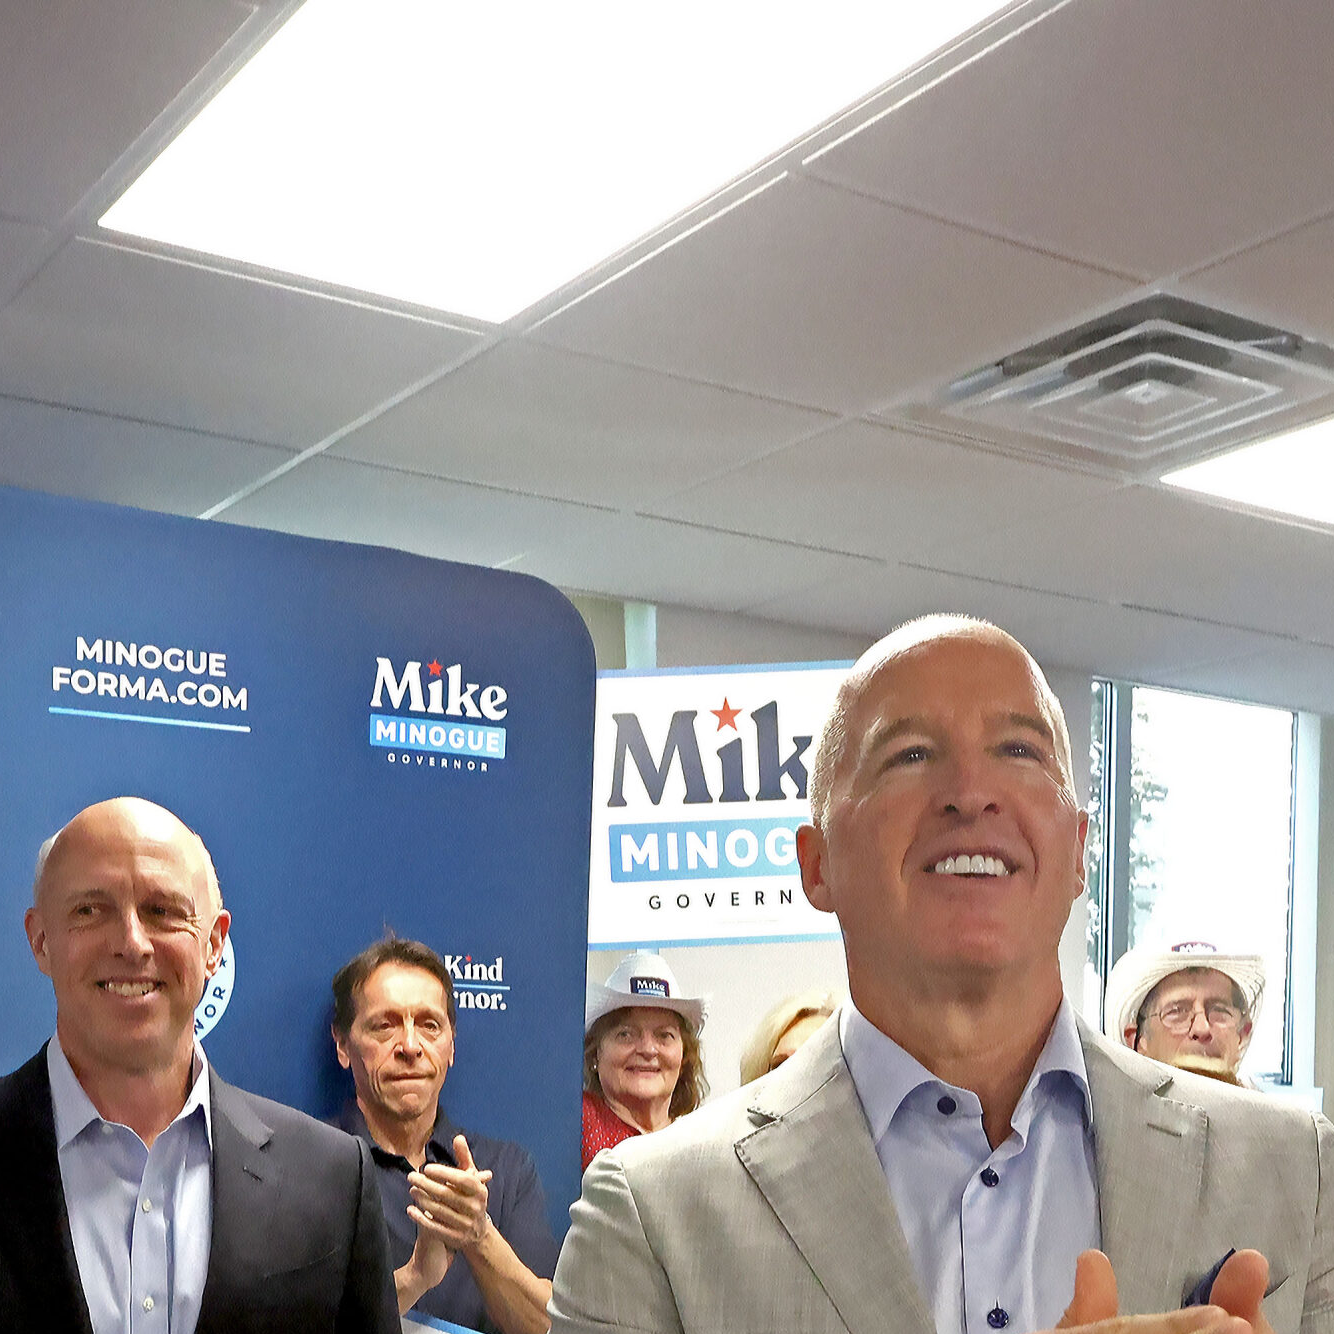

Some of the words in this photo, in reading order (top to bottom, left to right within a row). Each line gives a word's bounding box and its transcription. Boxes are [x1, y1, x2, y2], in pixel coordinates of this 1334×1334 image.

[75, 636, 227, 678] MINOGUE
[52, 667, 248, 712] FORMA.COM
[369, 658, 508, 721] Mike
[376, 720, 502, 753] MINOGUE
[608, 701, 813, 807] Mik
[388, 753, 489, 773] GOVERNOR
[620, 827, 796, 872] MINOG
[649, 890, 792, 909] GOVERN
[444, 955, 503, 982] Kind
